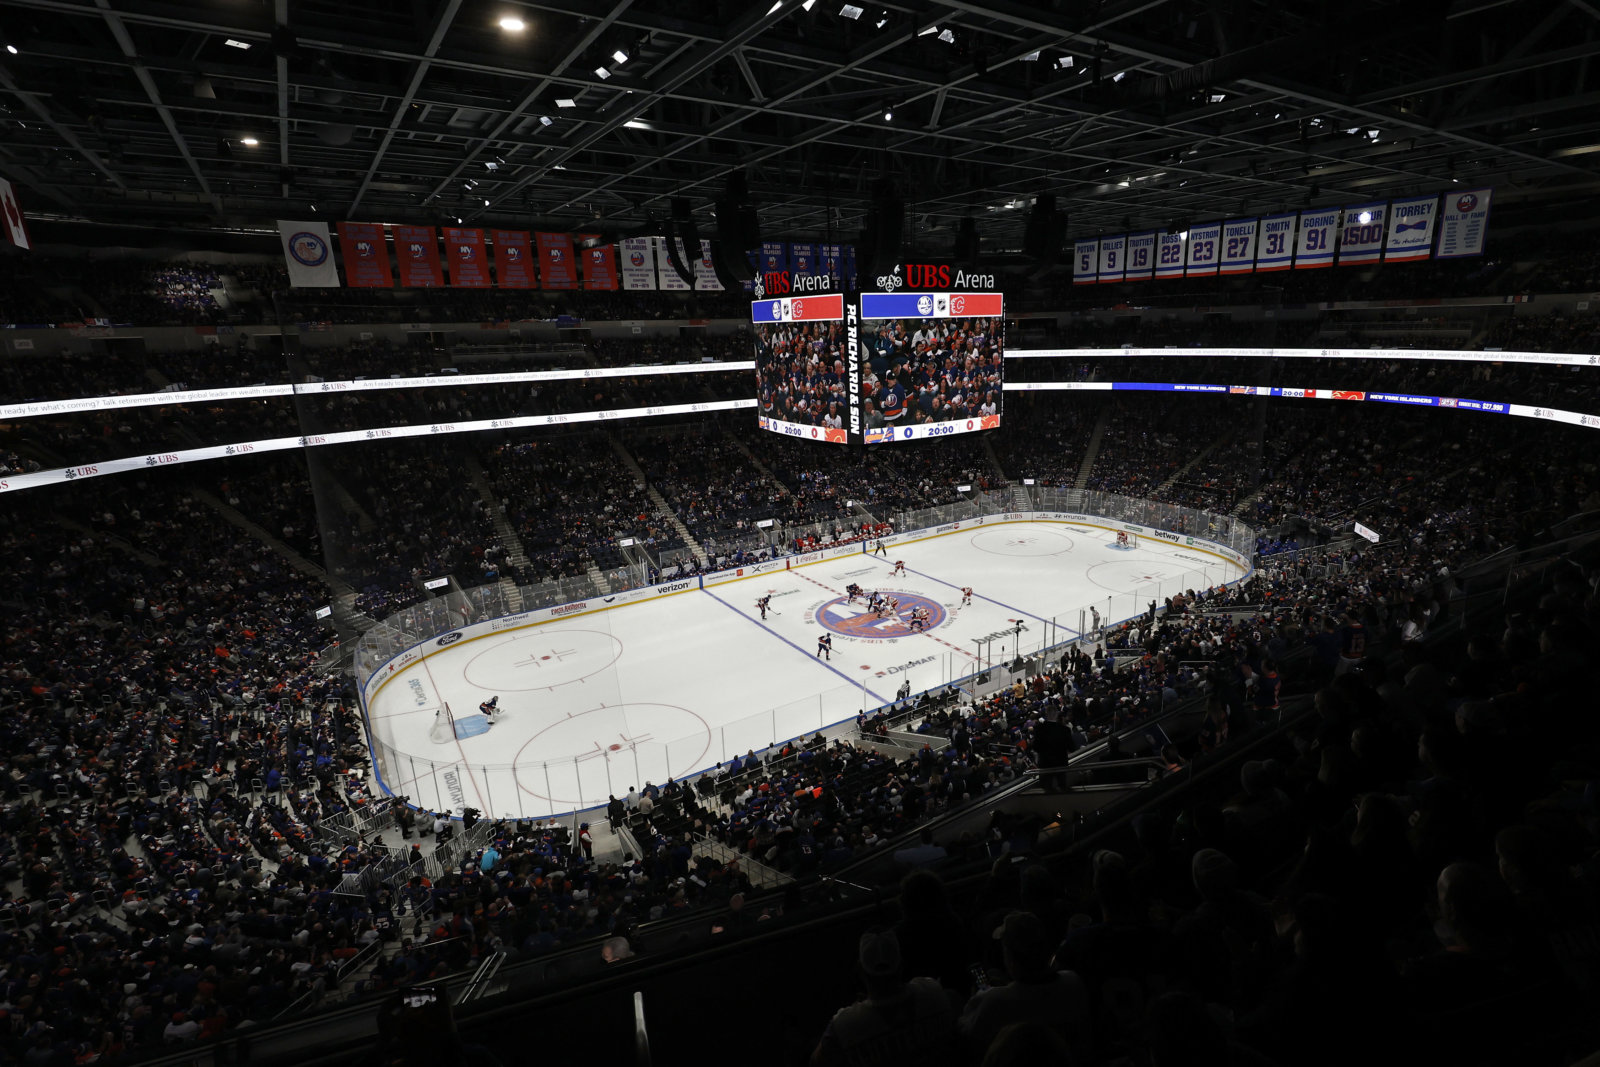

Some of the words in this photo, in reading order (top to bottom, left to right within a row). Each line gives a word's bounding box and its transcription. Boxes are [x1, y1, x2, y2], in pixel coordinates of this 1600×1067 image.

[1396, 203, 1433, 218] TORREY
[1266, 221, 1290, 233] SMITH
[1304, 215, 1334, 228] GORING
[1191, 230, 1219, 240] NYSTROM
[1226, 225, 1255, 237] TONELLI
[1342, 224, 1383, 245] 1500
[1103, 241, 1123, 250] GILLIES
[1266, 232, 1285, 254] 31
[1306, 228, 1327, 250] 91
[1161, 244, 1181, 264] 22
[1193, 241, 1214, 261] 23
[1227, 237, 1249, 258] 27
[1081, 254, 1089, 271] 5
[1108, 252, 1116, 268] 9
[1132, 248, 1148, 266] 19
[764, 271, 791, 295] UBS
[793, 274, 830, 292] Arena
[905, 264, 951, 288] UBS
[955, 270, 994, 289] Arena
[848, 326, 859, 394] RICHARD
[850, 394, 859, 405] &
[4, 407, 26, 415] ready
[41, 404, 66, 412] what's
[67, 400, 100, 409] coming?
[1542, 409, 1554, 417] UBS
[850, 406, 860, 435] SON
[1588, 417, 1600, 426] UBS
[785, 426, 801, 436] 20:00
[811, 428, 818, 438] 0
[904, 427, 913, 438] 0
[928, 426, 954, 435] 20:00
[967, 420, 973, 430] 0
[236, 444, 253, 453] UBS
[158, 454, 178, 463] UBS
[77, 466, 98, 477] UBS
[1155, 530, 1180, 542] betway
[657, 582, 689, 594] verizon
